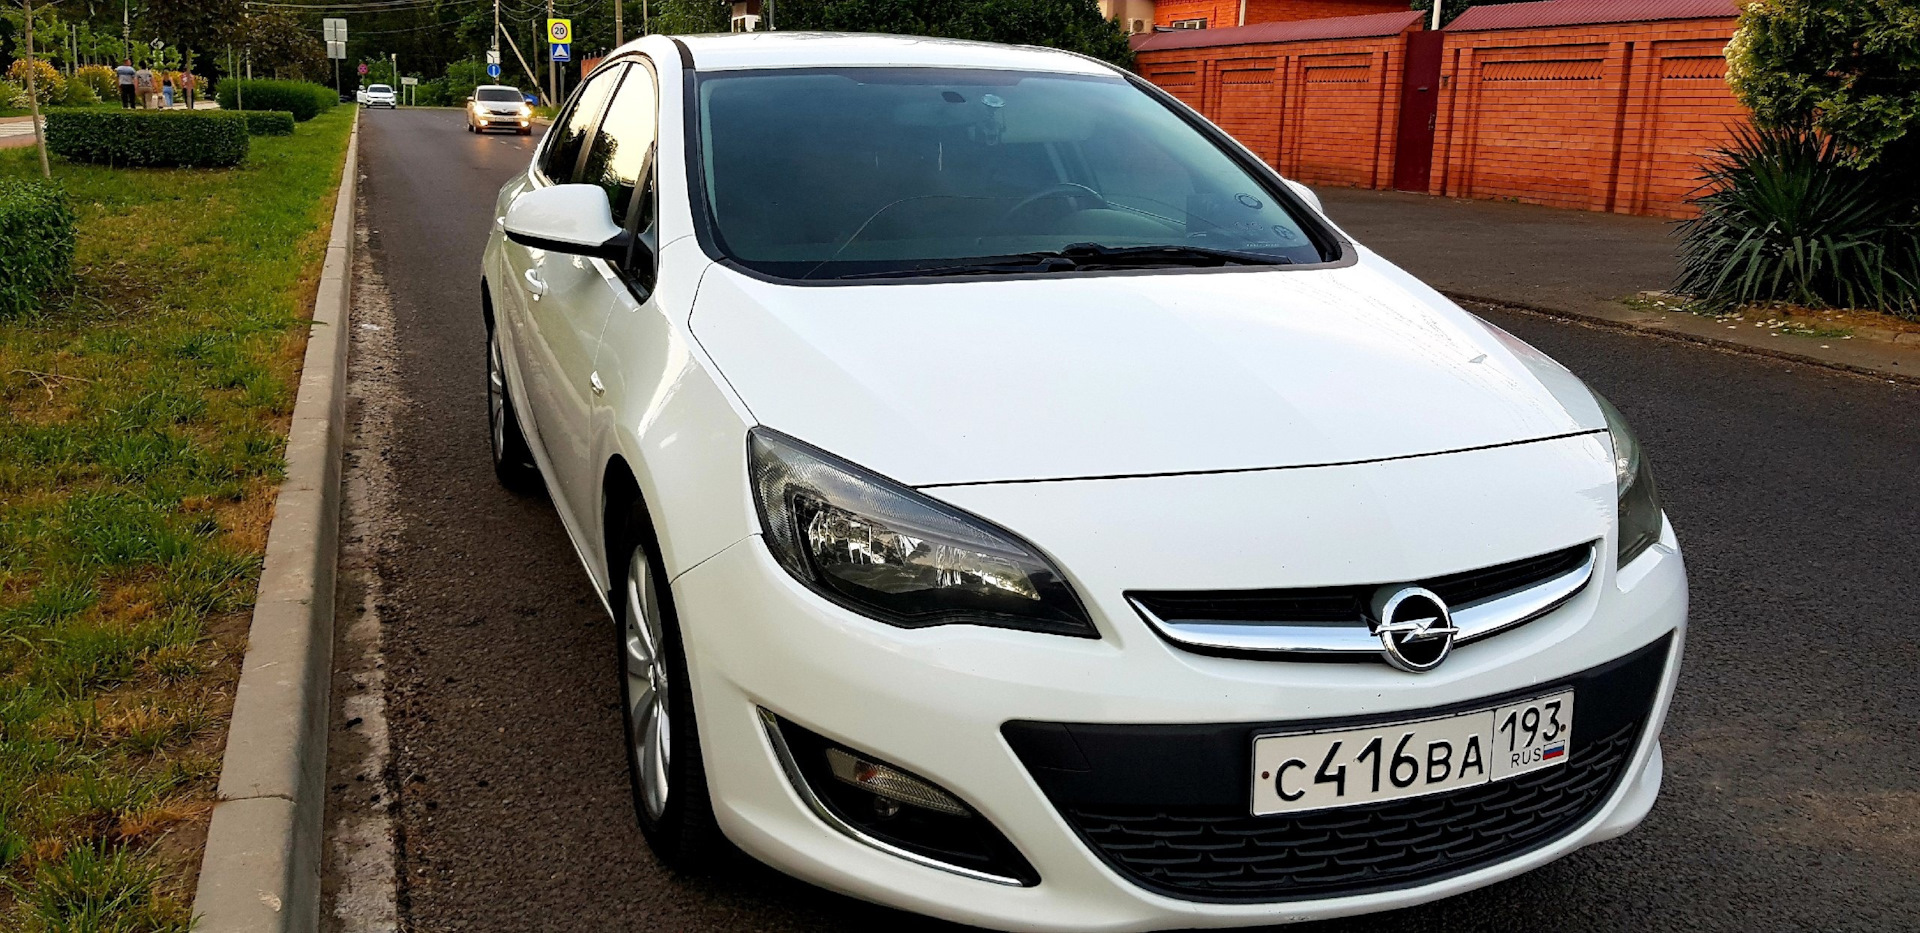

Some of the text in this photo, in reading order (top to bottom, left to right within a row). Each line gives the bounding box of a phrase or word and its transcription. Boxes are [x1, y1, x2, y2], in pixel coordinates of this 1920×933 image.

[554, 27, 565, 35] 20
[1499, 699, 1561, 752] 193
[1511, 748, 1541, 768] RUS
